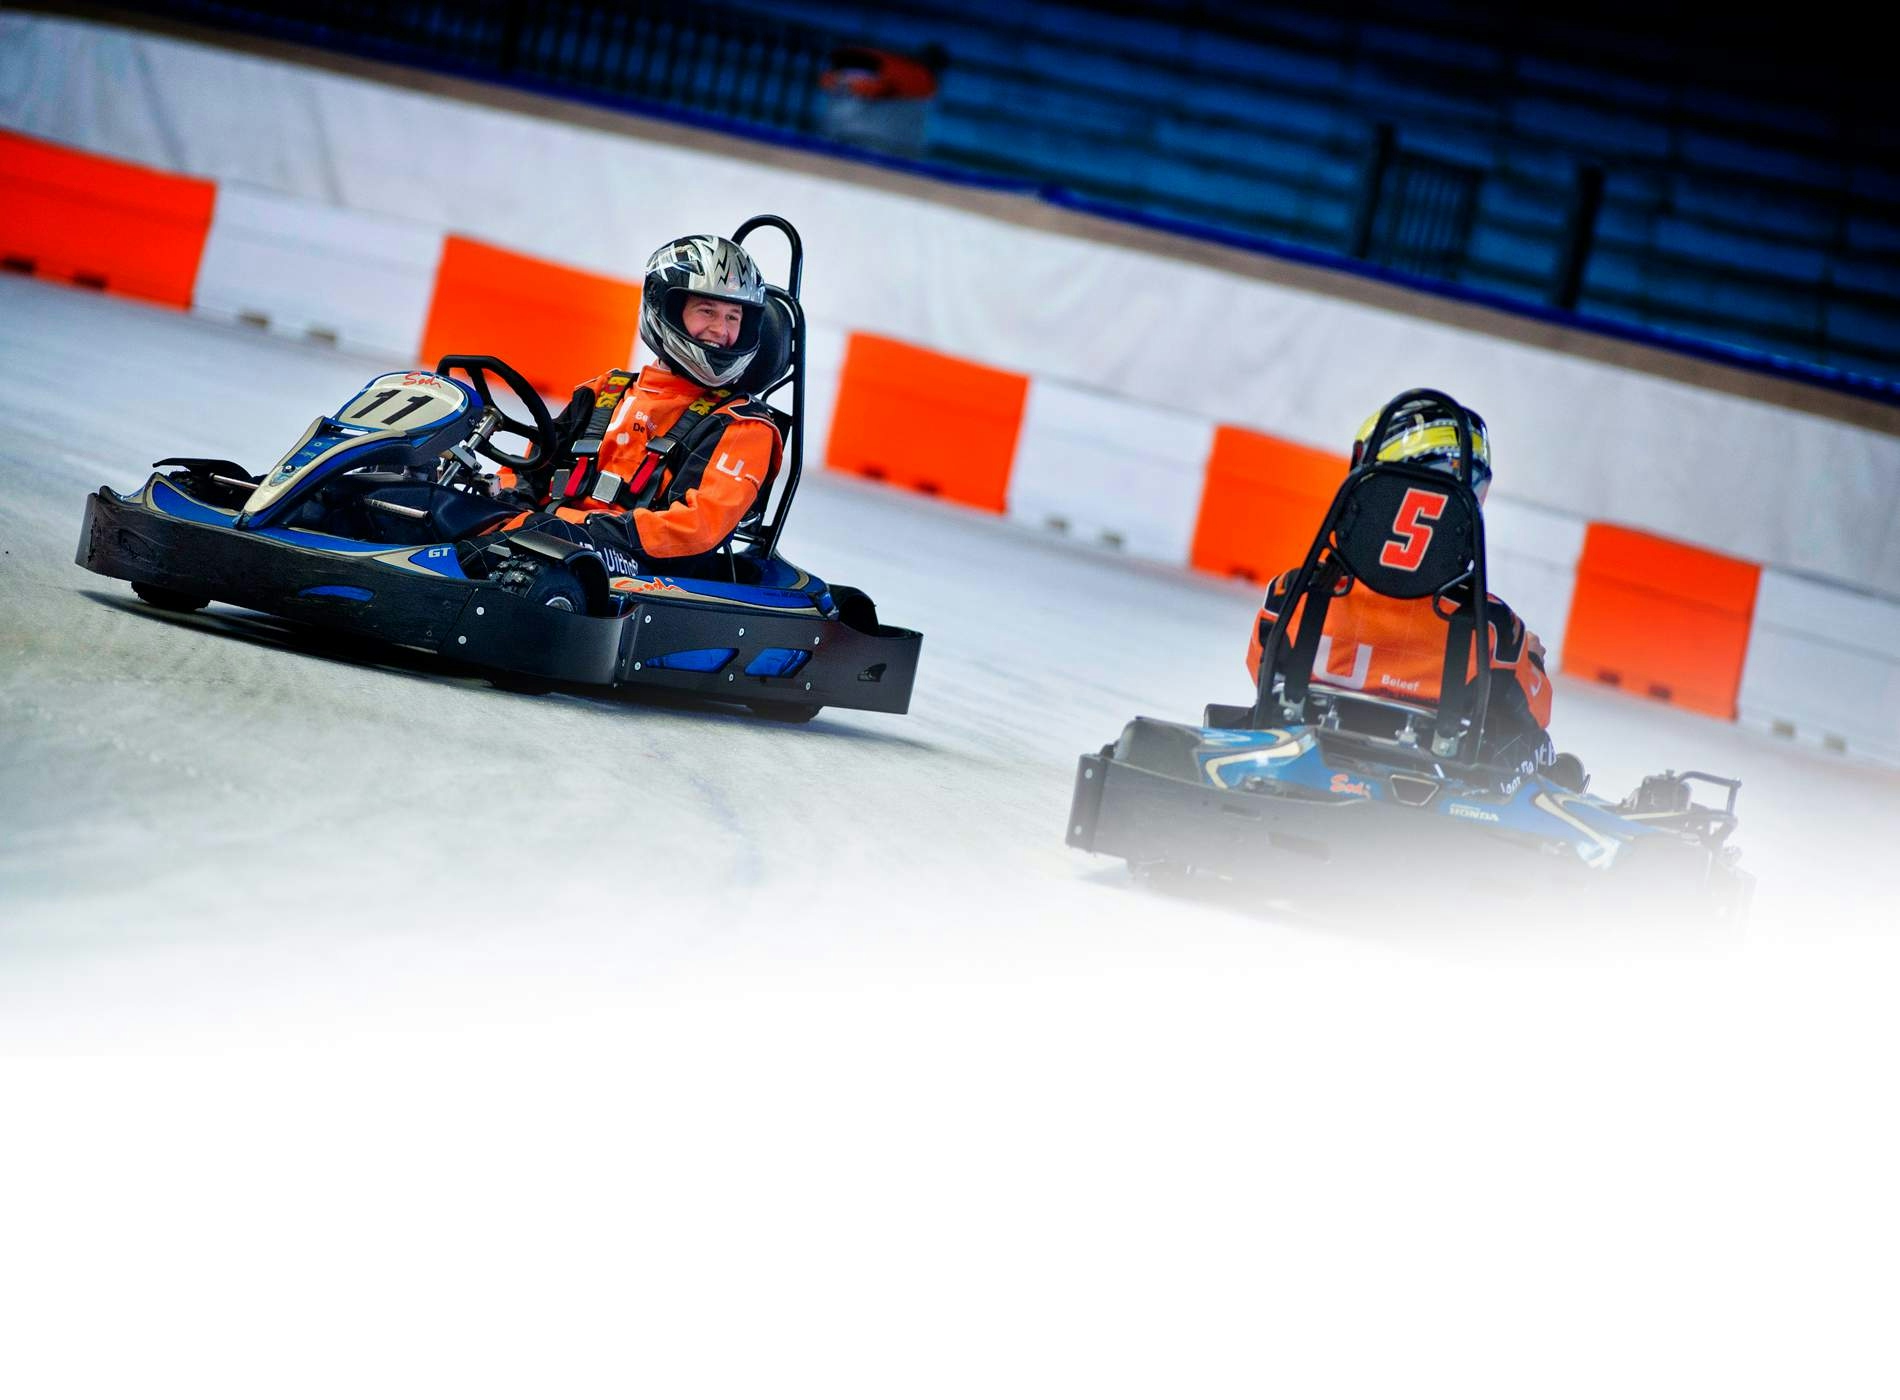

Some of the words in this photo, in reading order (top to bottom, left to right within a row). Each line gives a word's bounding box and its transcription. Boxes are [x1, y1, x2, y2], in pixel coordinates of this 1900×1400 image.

[350, 389, 435, 426] 11
[1379, 487, 1449, 572] 5
[428, 546, 451, 558] GT
[1311, 634, 1373, 690] U
[1380, 674, 1420, 692] Beleef
[1450, 806, 1499, 821] HONDA
